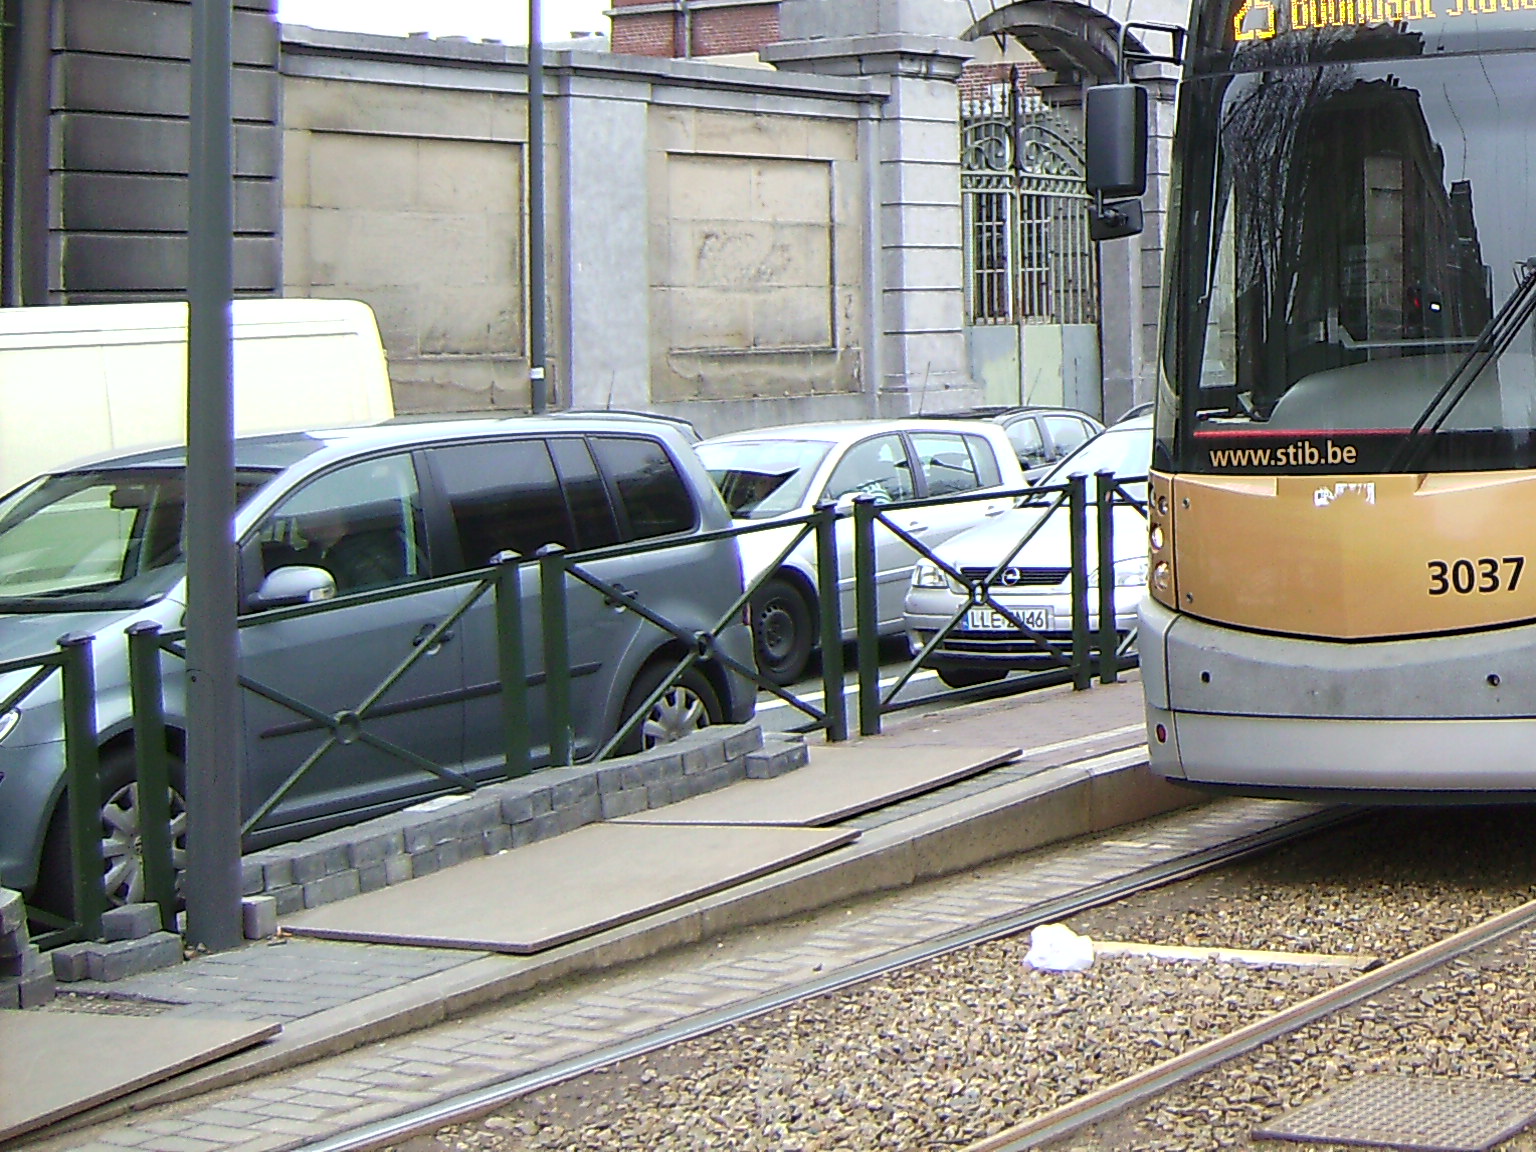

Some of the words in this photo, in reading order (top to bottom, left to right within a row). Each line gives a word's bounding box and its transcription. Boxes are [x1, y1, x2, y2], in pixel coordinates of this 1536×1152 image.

[1210, 440, 1357, 467] www.stib.be
[1427, 556, 1525, 595] 3037
[970, 611, 1001, 628] LLE
